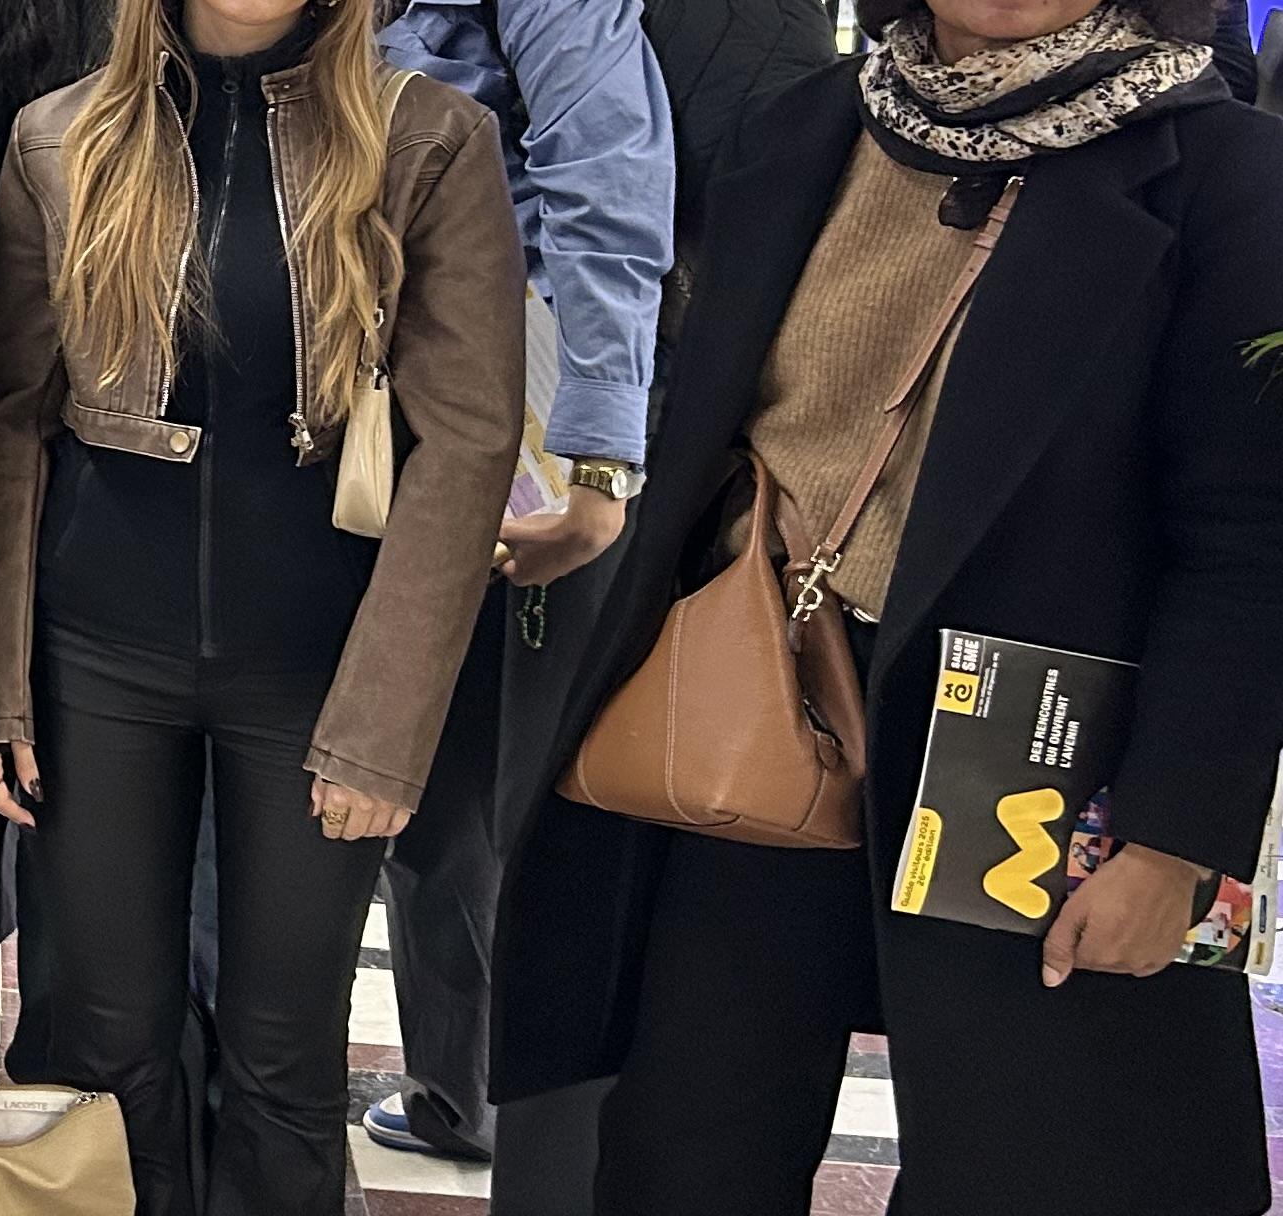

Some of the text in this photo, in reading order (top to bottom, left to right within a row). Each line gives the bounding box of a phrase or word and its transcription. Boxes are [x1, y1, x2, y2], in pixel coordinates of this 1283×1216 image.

[950, 636, 964, 670] SALON
[961, 638, 980, 672] SME
[1028, 668, 1060, 764] DES RENCONTRES
[1044, 694, 1071, 767] QUI OUVRENT
[1059, 719, 1081, 769] L'AVENIR
[900, 880, 915, 908] Guide
[3, 1100, 49, 1111] LACOSTE
